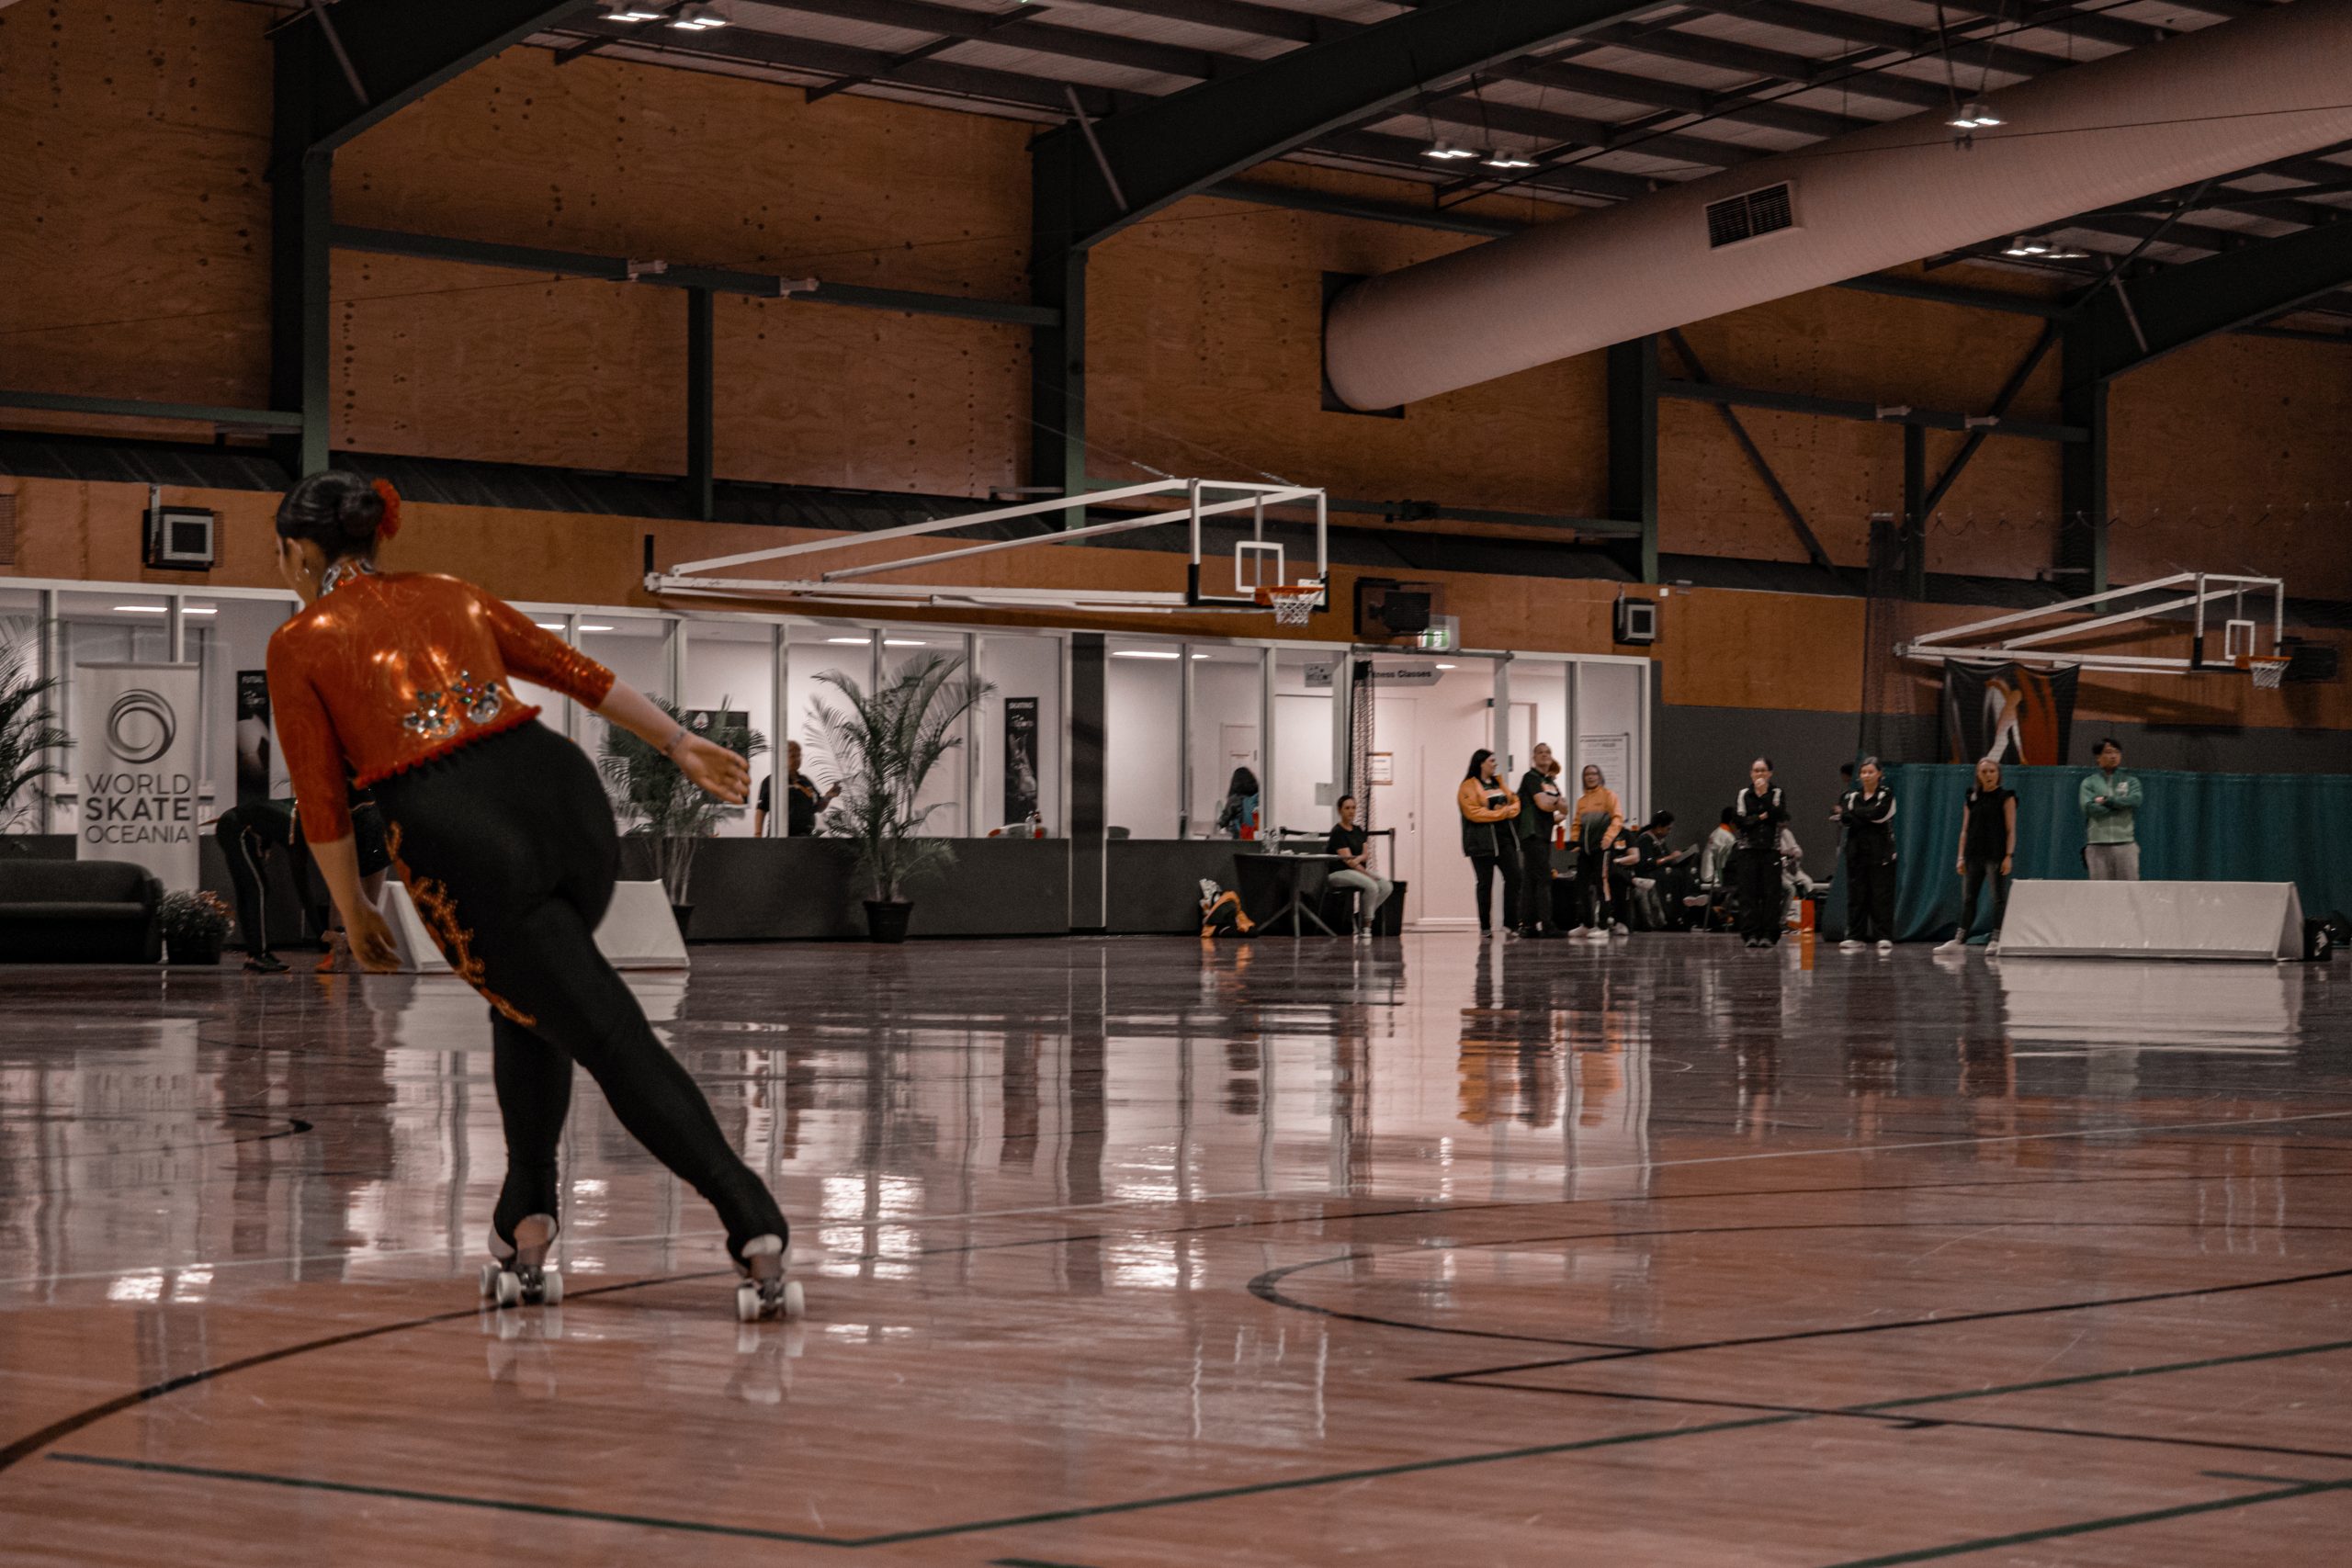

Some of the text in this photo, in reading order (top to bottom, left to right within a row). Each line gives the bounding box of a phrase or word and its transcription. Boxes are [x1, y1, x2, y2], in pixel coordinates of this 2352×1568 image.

[1397, 670, 1431, 678] Classes
[85, 773, 191, 795] WORLD
[85, 796, 191, 821] SKATE
[85, 825, 191, 843] OCEANIA
